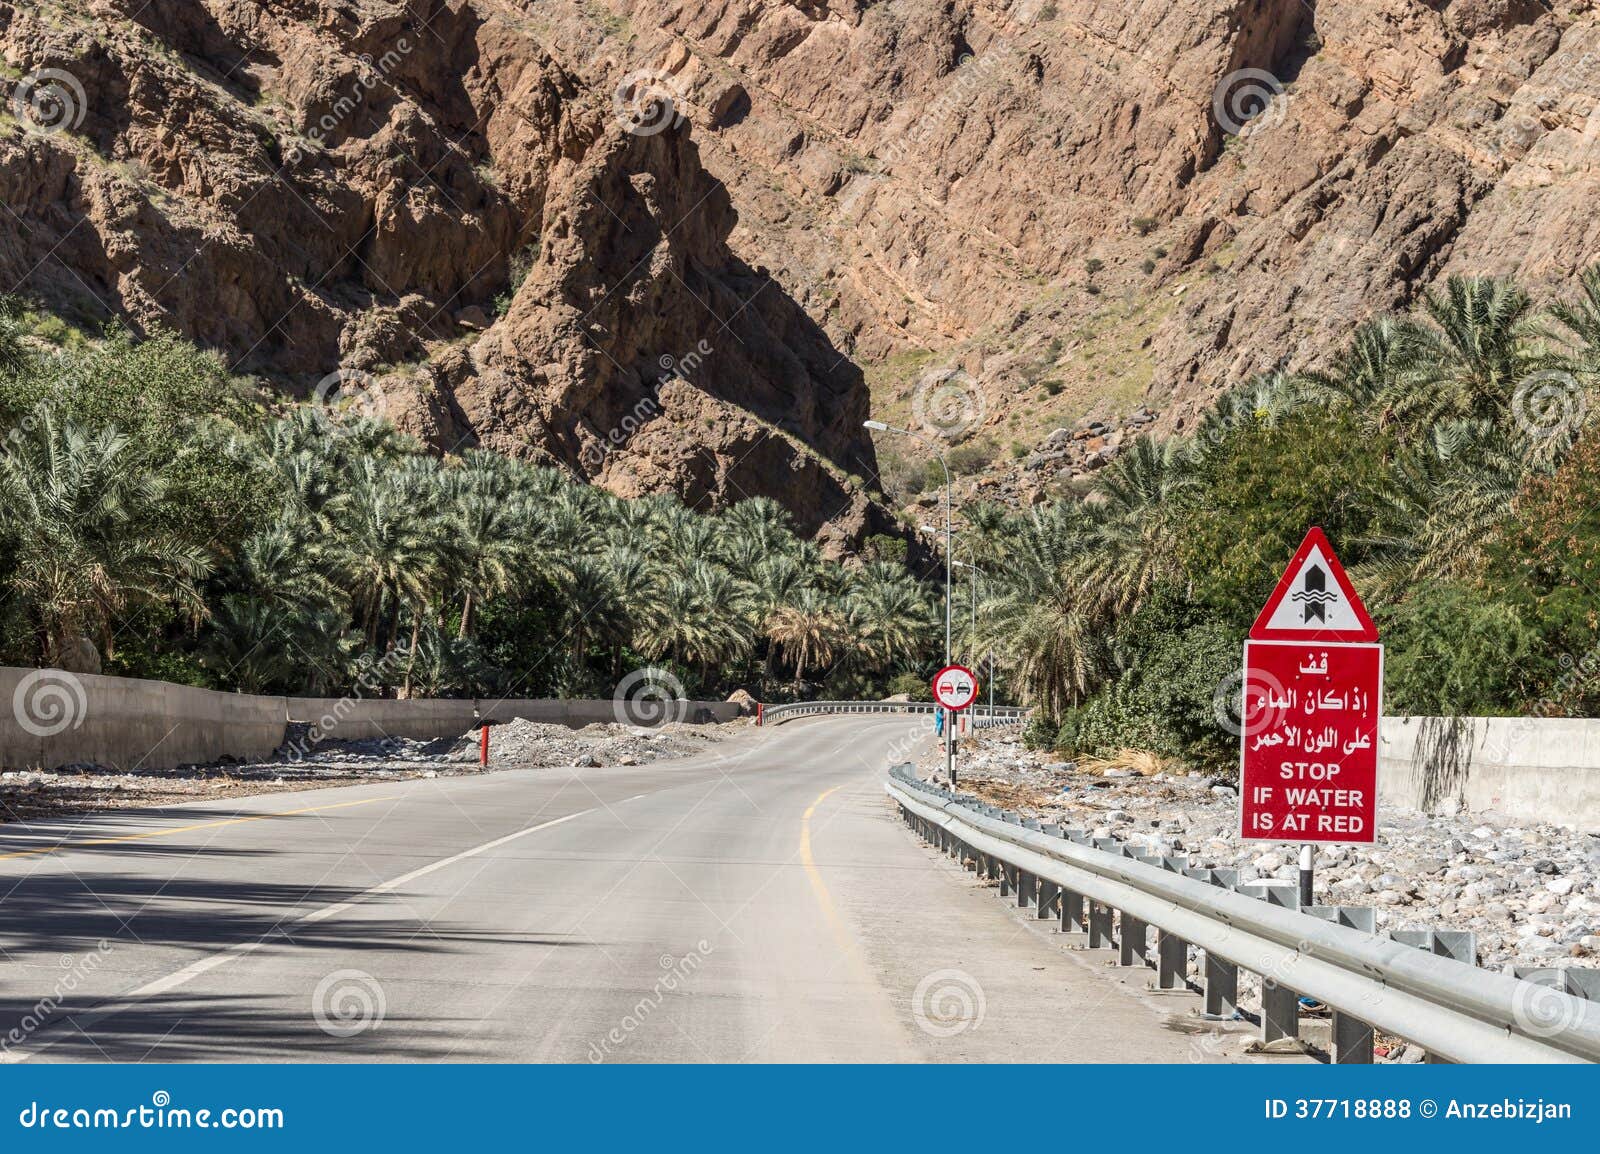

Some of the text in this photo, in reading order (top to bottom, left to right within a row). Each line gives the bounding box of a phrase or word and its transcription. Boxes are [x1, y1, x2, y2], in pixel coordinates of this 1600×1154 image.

[1299, 652, 1329, 674] قف
[1257, 687, 1297, 710] الماء
[1304, 726, 1338, 753] اللون
[1342, 726, 1371, 755] على
[1279, 761, 1341, 781] STOP
[1253, 786, 1364, 808] IF WATER
[1252, 812, 1364, 833] IS AT RED
